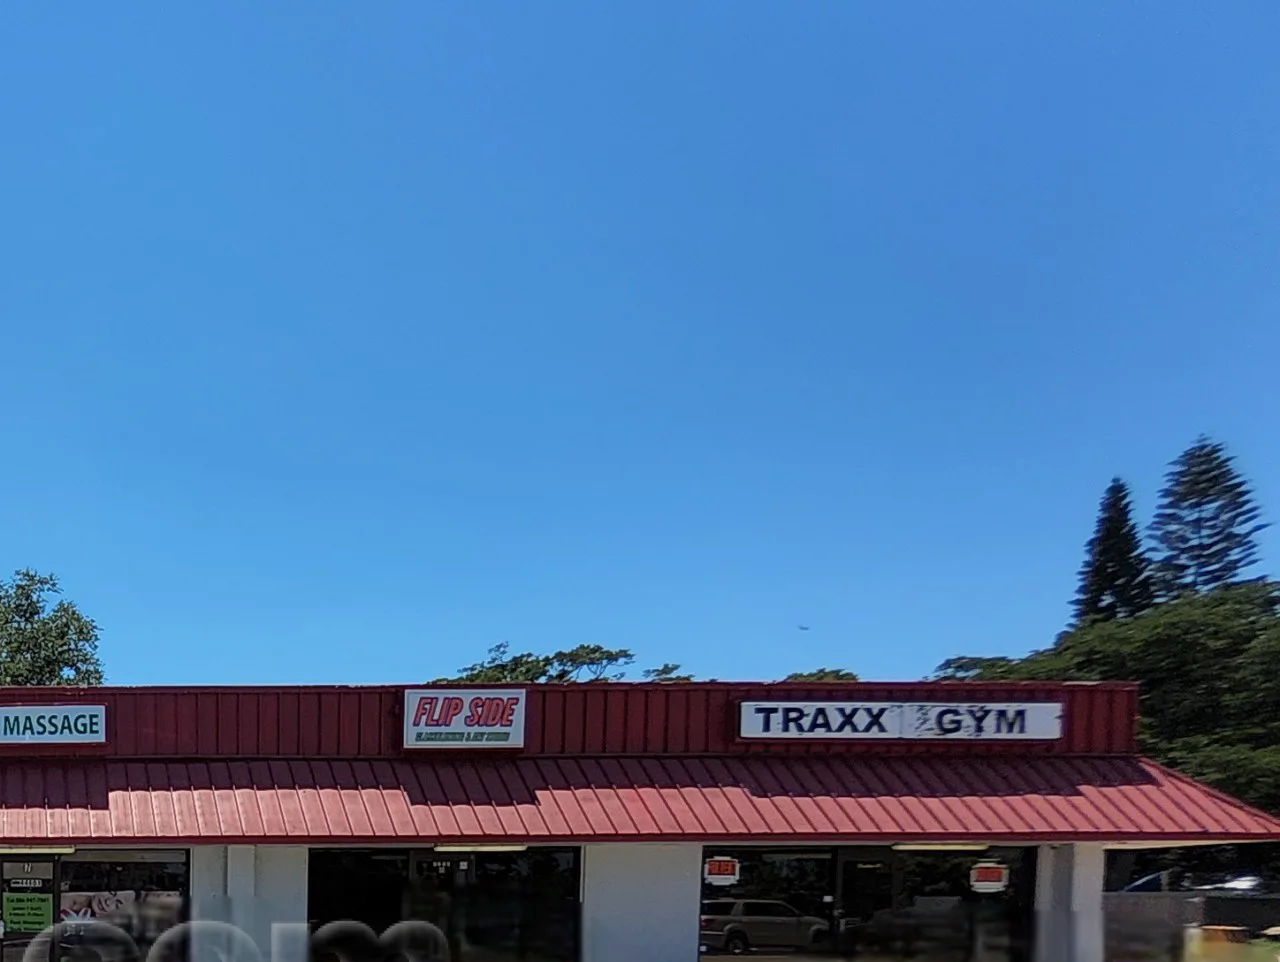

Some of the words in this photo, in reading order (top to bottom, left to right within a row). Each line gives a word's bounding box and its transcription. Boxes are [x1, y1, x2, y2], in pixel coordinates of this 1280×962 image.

[3, 714, 100, 736] MASSAGE
[412, 696, 464, 727] FLIP
[464, 696, 520, 727] SIDE
[754, 707, 889, 733] TRAXX
[935, 708, 1027, 734] GYM
